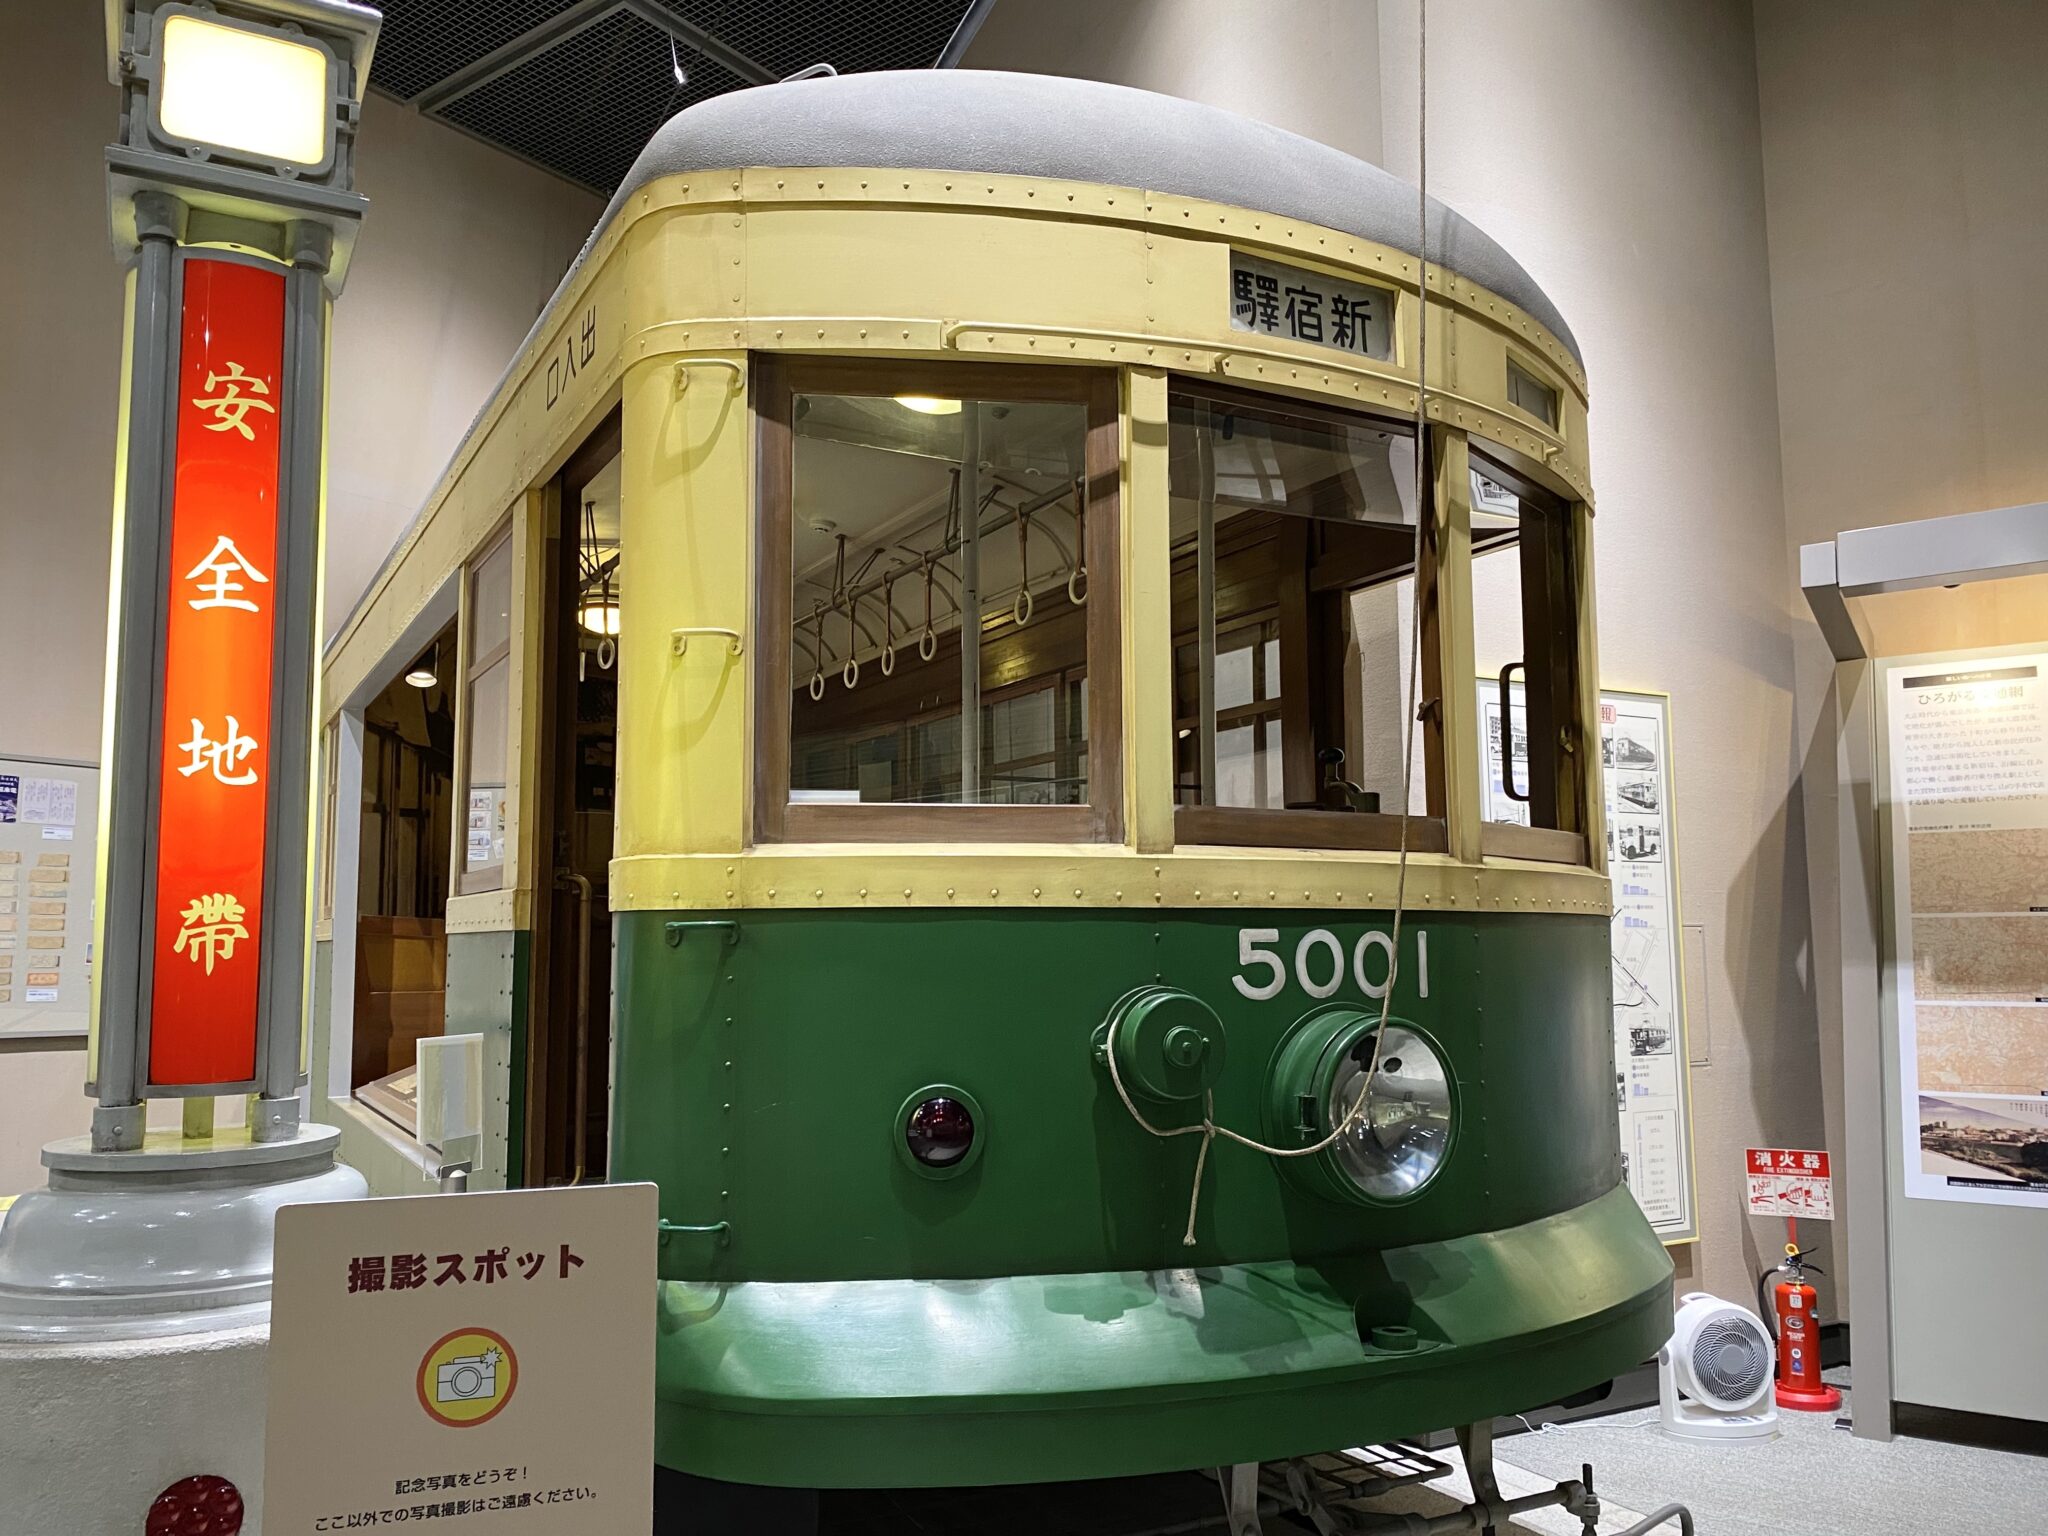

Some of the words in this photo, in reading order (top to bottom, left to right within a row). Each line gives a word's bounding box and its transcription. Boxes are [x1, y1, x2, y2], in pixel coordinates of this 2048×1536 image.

[1232, 928, 1428, 1000] 5001
[1755, 1151, 1821, 1169] 消火器
[348, 1244, 585, 1294] 撮影スポット
[314, 1487, 599, 1532] ここ以外での写真撮影はご遠慮ください。
